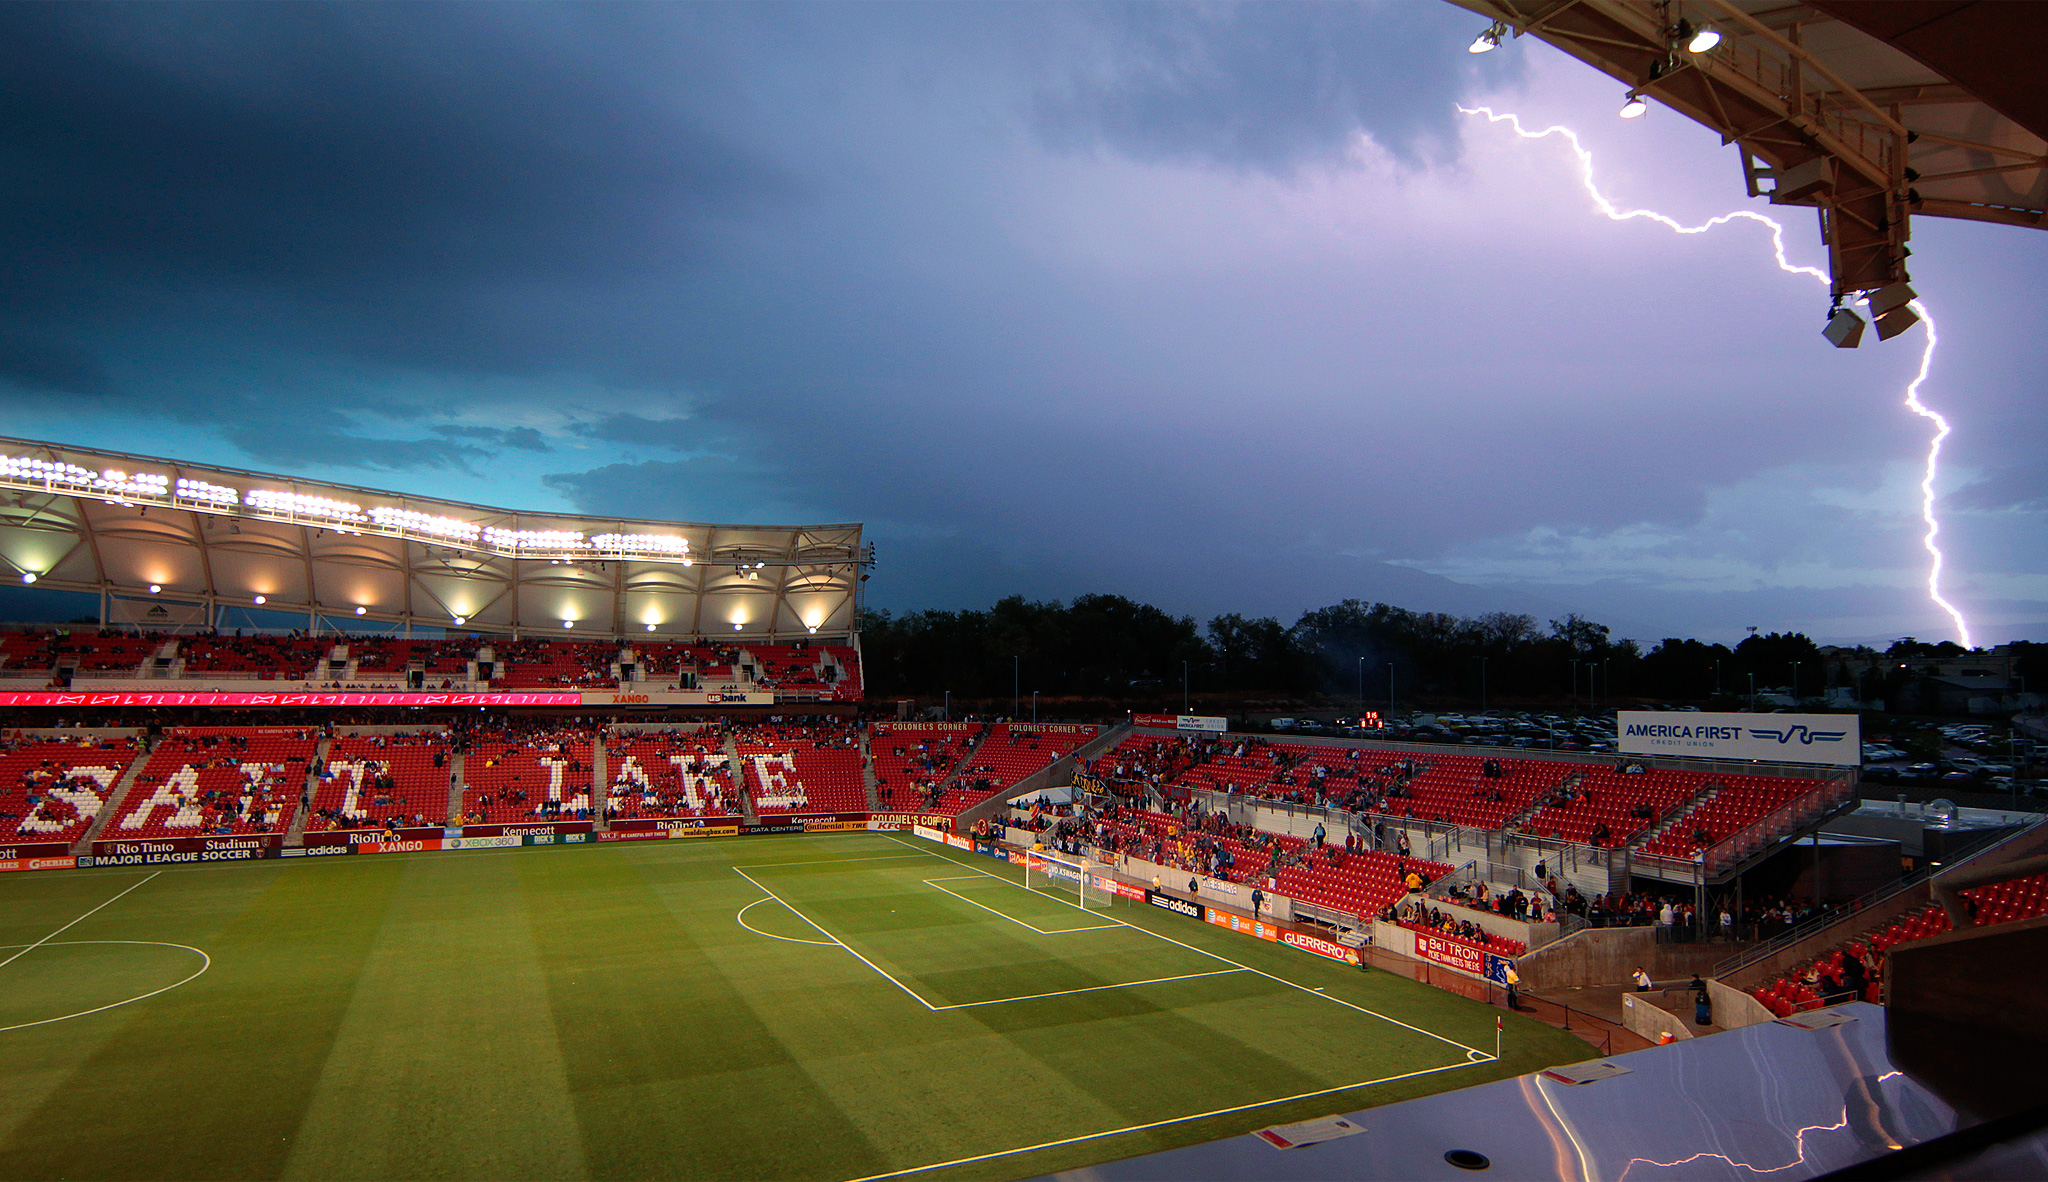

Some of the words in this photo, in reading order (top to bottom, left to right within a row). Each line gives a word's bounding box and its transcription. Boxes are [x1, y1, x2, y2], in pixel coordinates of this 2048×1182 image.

[612, 694, 649, 704] XANGO
[892, 723, 934, 731] COLONEL'S
[937, 723, 968, 731] CORNER
[1008, 724, 1047, 733] COLONEL'S
[1049, 725, 1076, 734] CORNER
[1626, 724, 1693, 739] AMERICA
[1695, 726, 1743, 740] FIRST
[871, 814, 919, 825] COLONEL'S
[502, 826, 555, 837] Kennecott
[804, 822, 845, 832] Continental
[116, 843, 139, 854] Rio
[141, 842, 175, 853] Tinto
[205, 839, 260, 850] Stadium
[379, 841, 423, 853] XANGO
[465, 838, 494, 848] XBOX
[496, 837, 515, 847] 360
[307, 845, 348, 856] adidas
[95, 855, 143, 866] MAJOR
[146, 852, 198, 863] LEAGUE
[201, 849, 251, 861] SOCCER
[1169, 899, 1198, 918] adidas
[1284, 932, 1345, 960] GUERRERO
[1448, 942, 1479, 961] TRON
